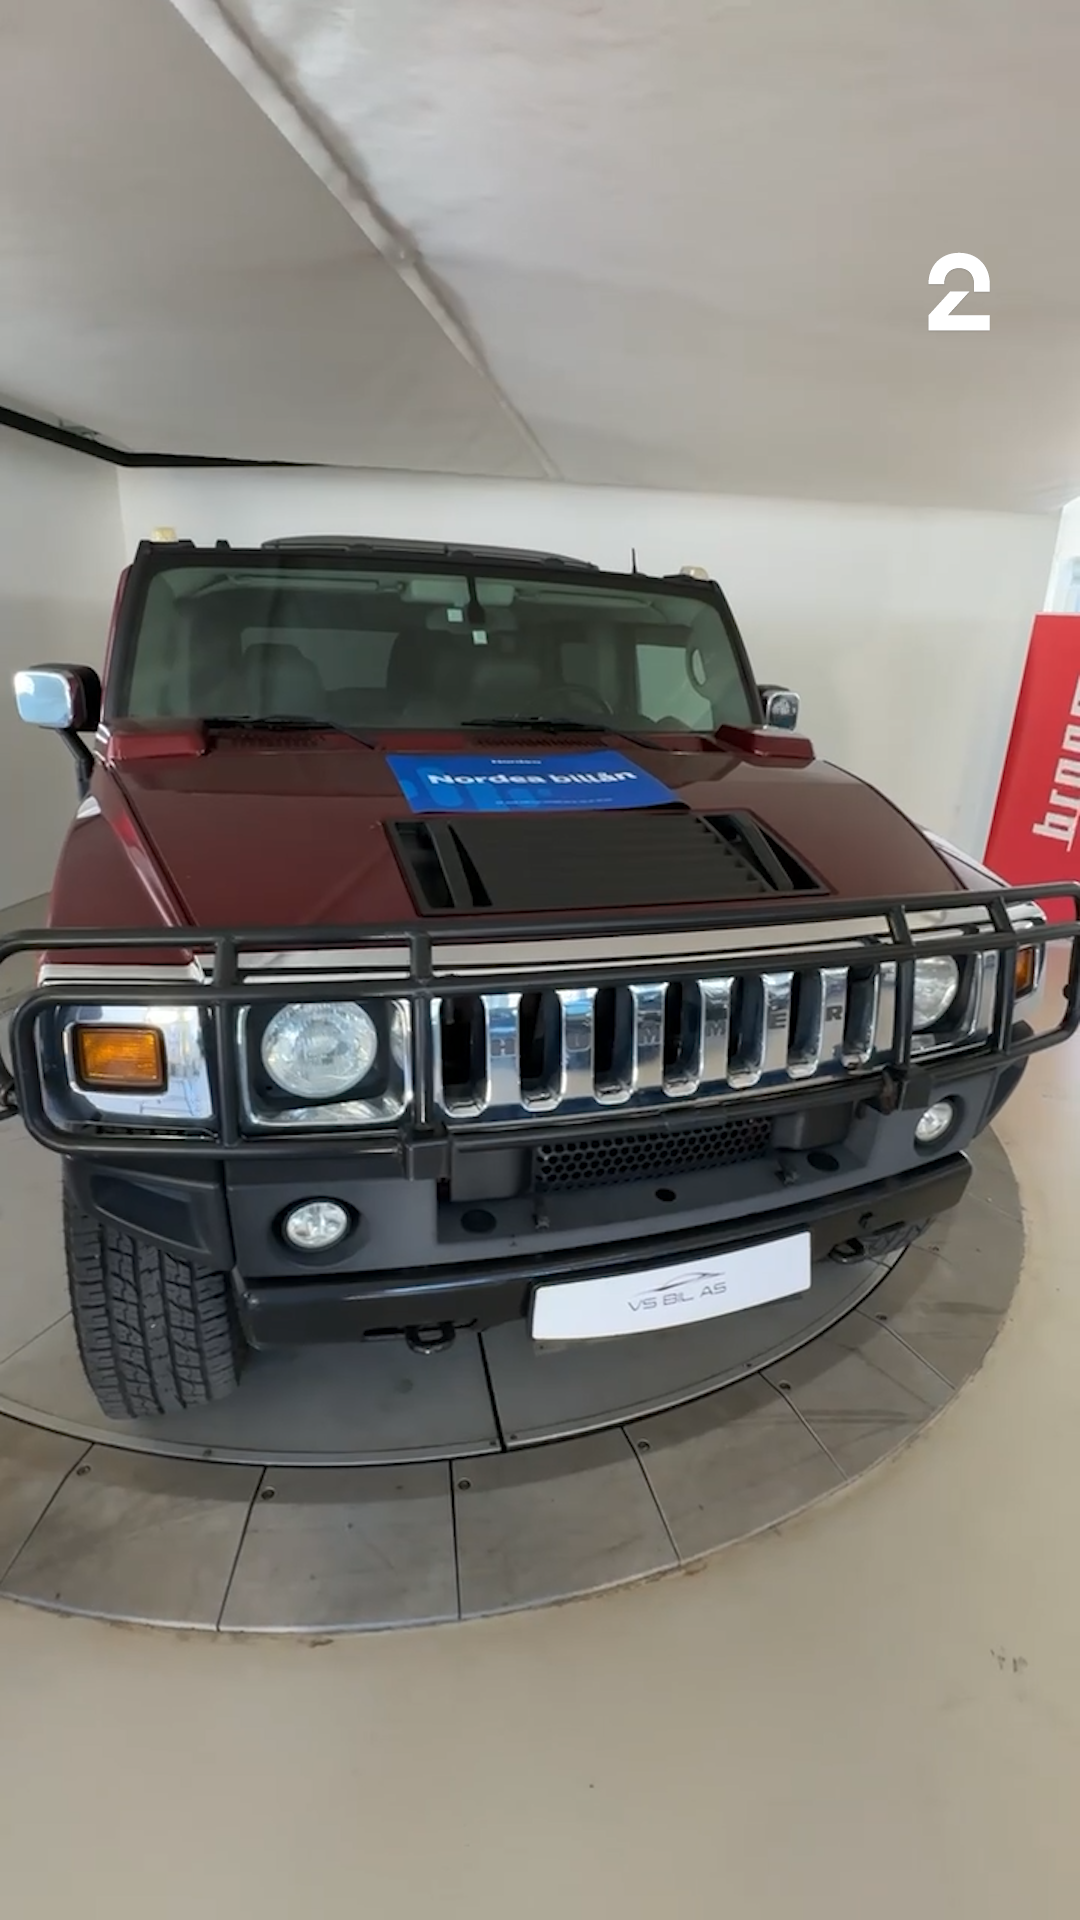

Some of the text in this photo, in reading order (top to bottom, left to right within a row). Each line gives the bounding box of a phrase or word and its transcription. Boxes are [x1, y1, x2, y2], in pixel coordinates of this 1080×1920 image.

[428, 770, 638, 786] Nordea billån
[627, 1282, 727, 1312] VS BIL AS
